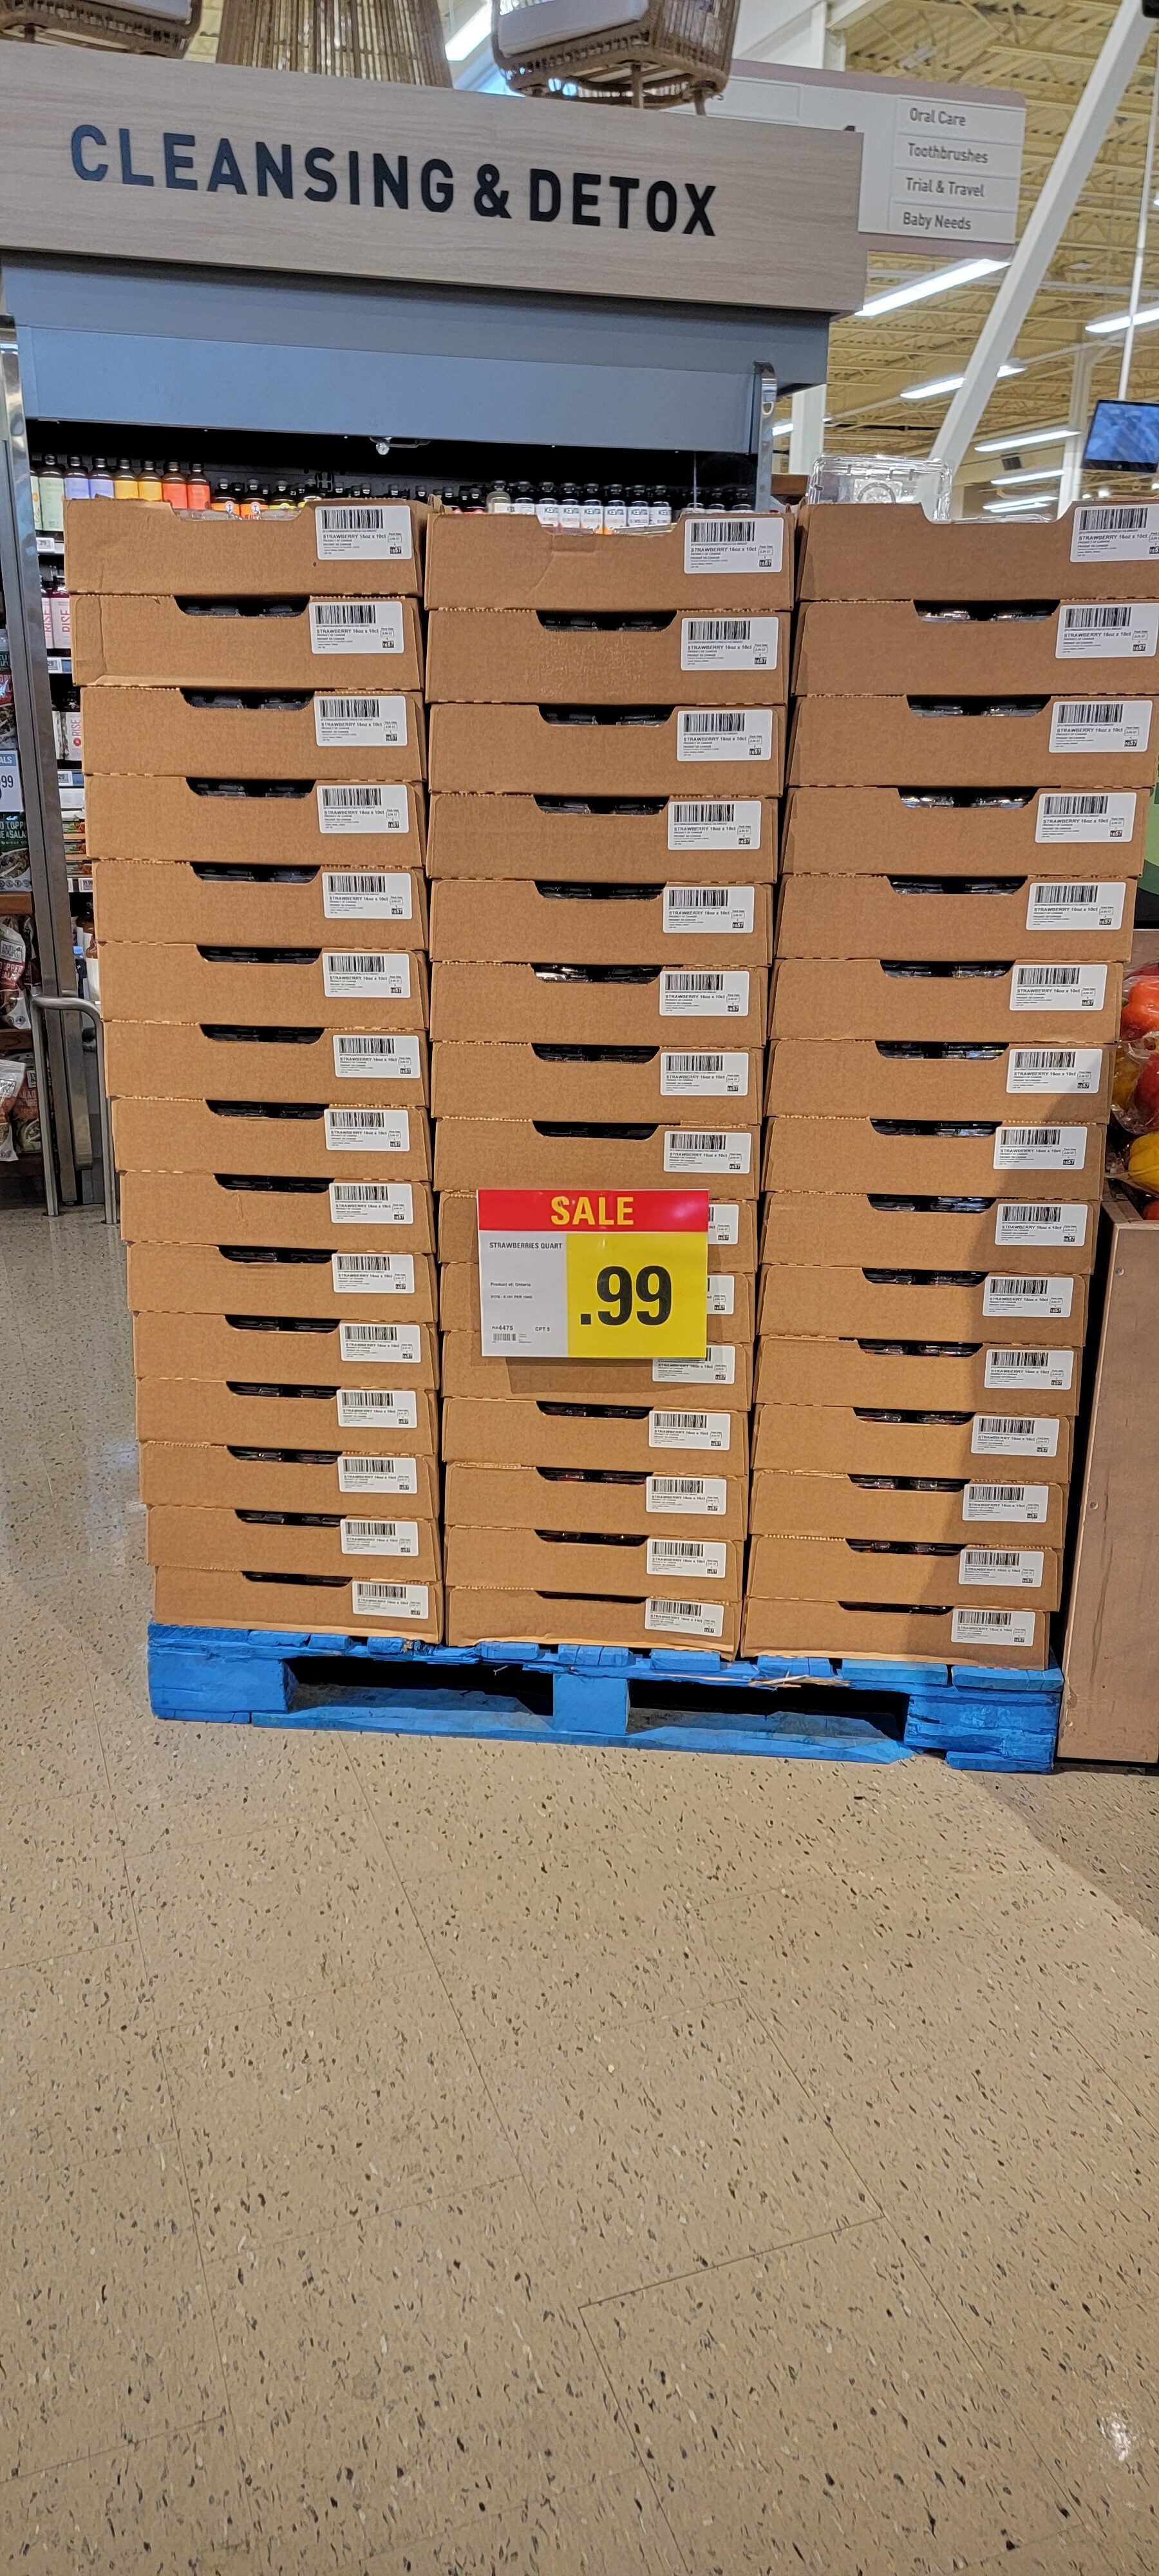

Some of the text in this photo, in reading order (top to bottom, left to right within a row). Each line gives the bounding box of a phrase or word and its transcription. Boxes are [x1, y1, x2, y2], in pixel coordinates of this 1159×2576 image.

[909, 108, 966, 126] Oral Care
[908, 142, 988, 164] Toothbrushes
[71, 124, 717, 237] CLEANSING & DETOX
[906, 177, 985, 197] Trial & Travel
[903, 211, 972, 231] Baby Needs
[71, 719, 82, 737] RISE
[551, 1196, 634, 1226] SALE
[580, 1265, 672, 1326] .99
